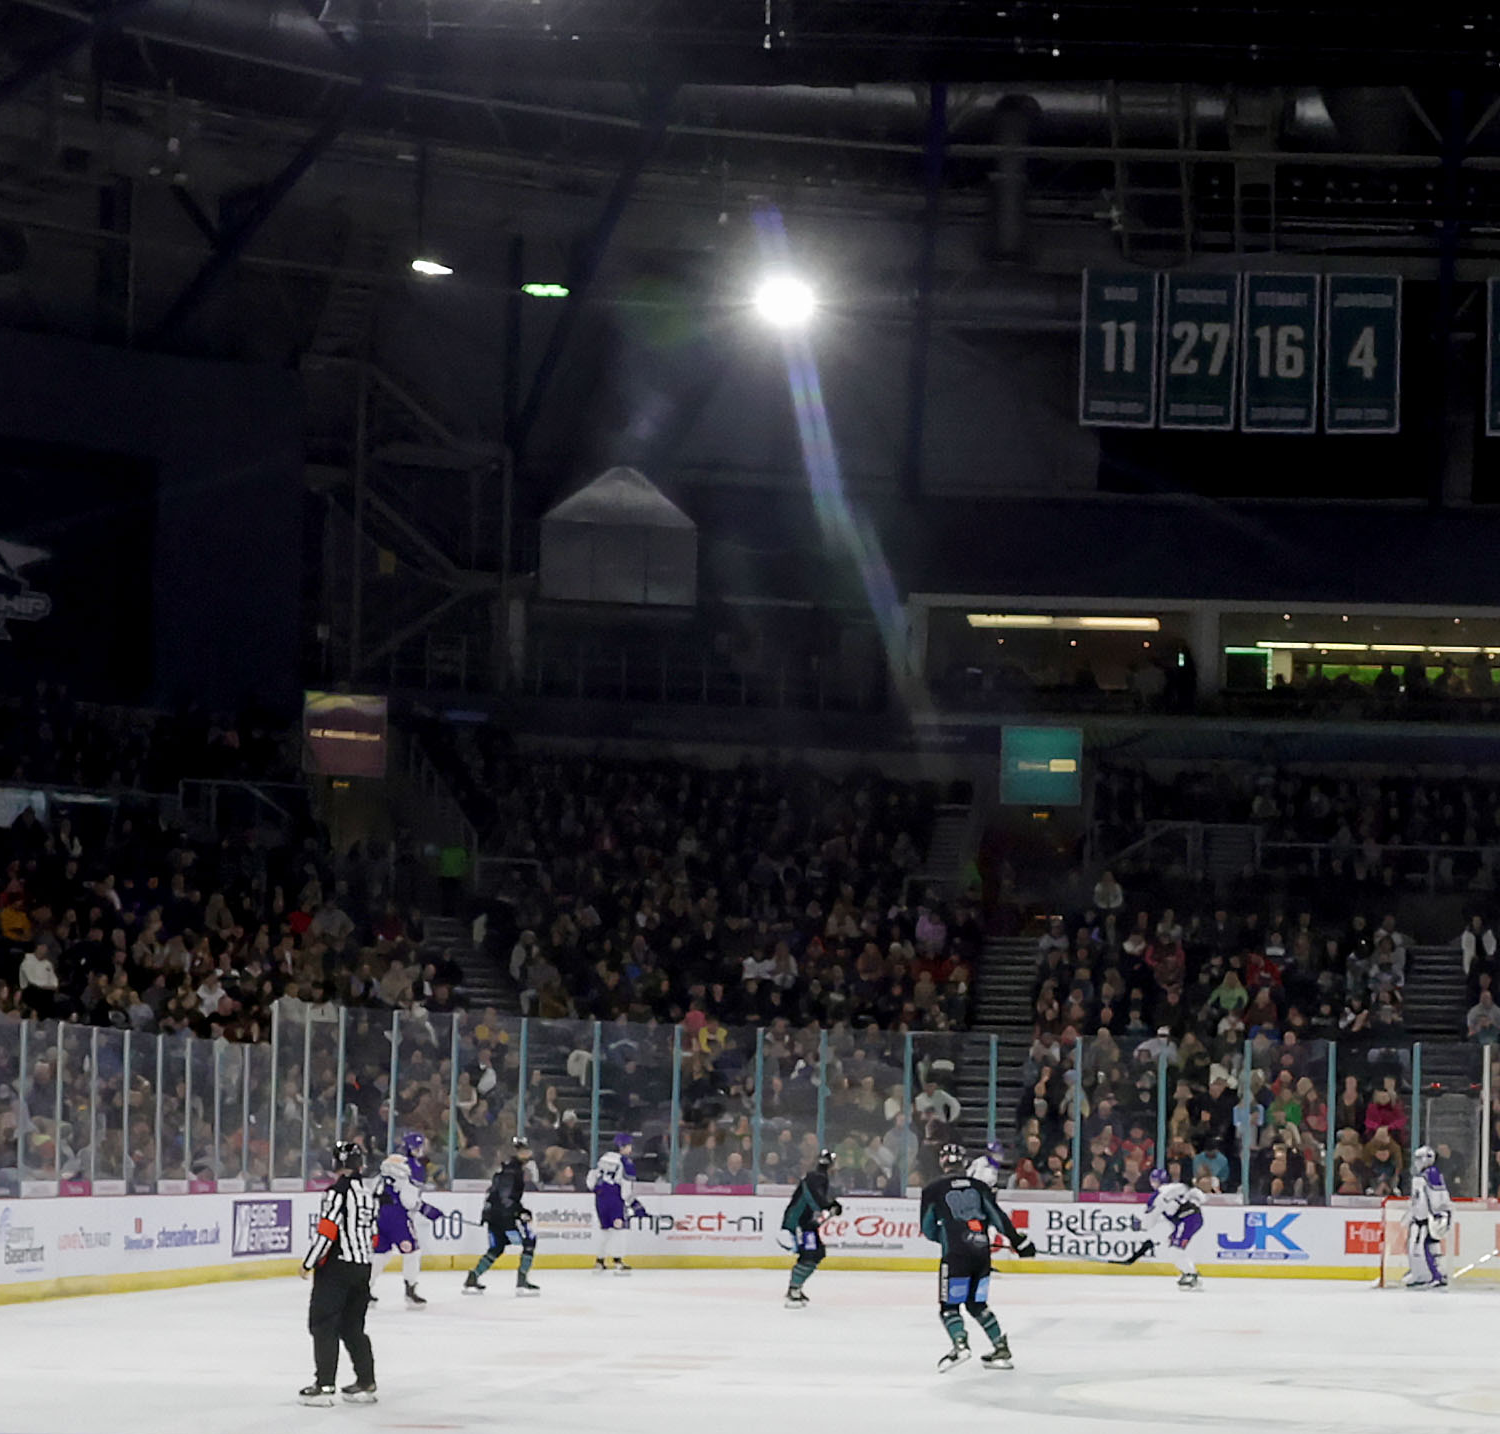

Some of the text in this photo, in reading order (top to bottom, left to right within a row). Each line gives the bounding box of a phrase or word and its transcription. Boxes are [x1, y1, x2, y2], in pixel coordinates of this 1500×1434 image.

[1100, 320, 1136, 373] 11
[1170, 321, 1231, 377] 27
[1255, 325, 1305, 379] 16
[1347, 325, 1378, 381] 4
[628, 1211, 764, 1235] mpact-ni
[1047, 1209, 1147, 1233] Belfast
[1217, 1211, 1302, 1251] JK
